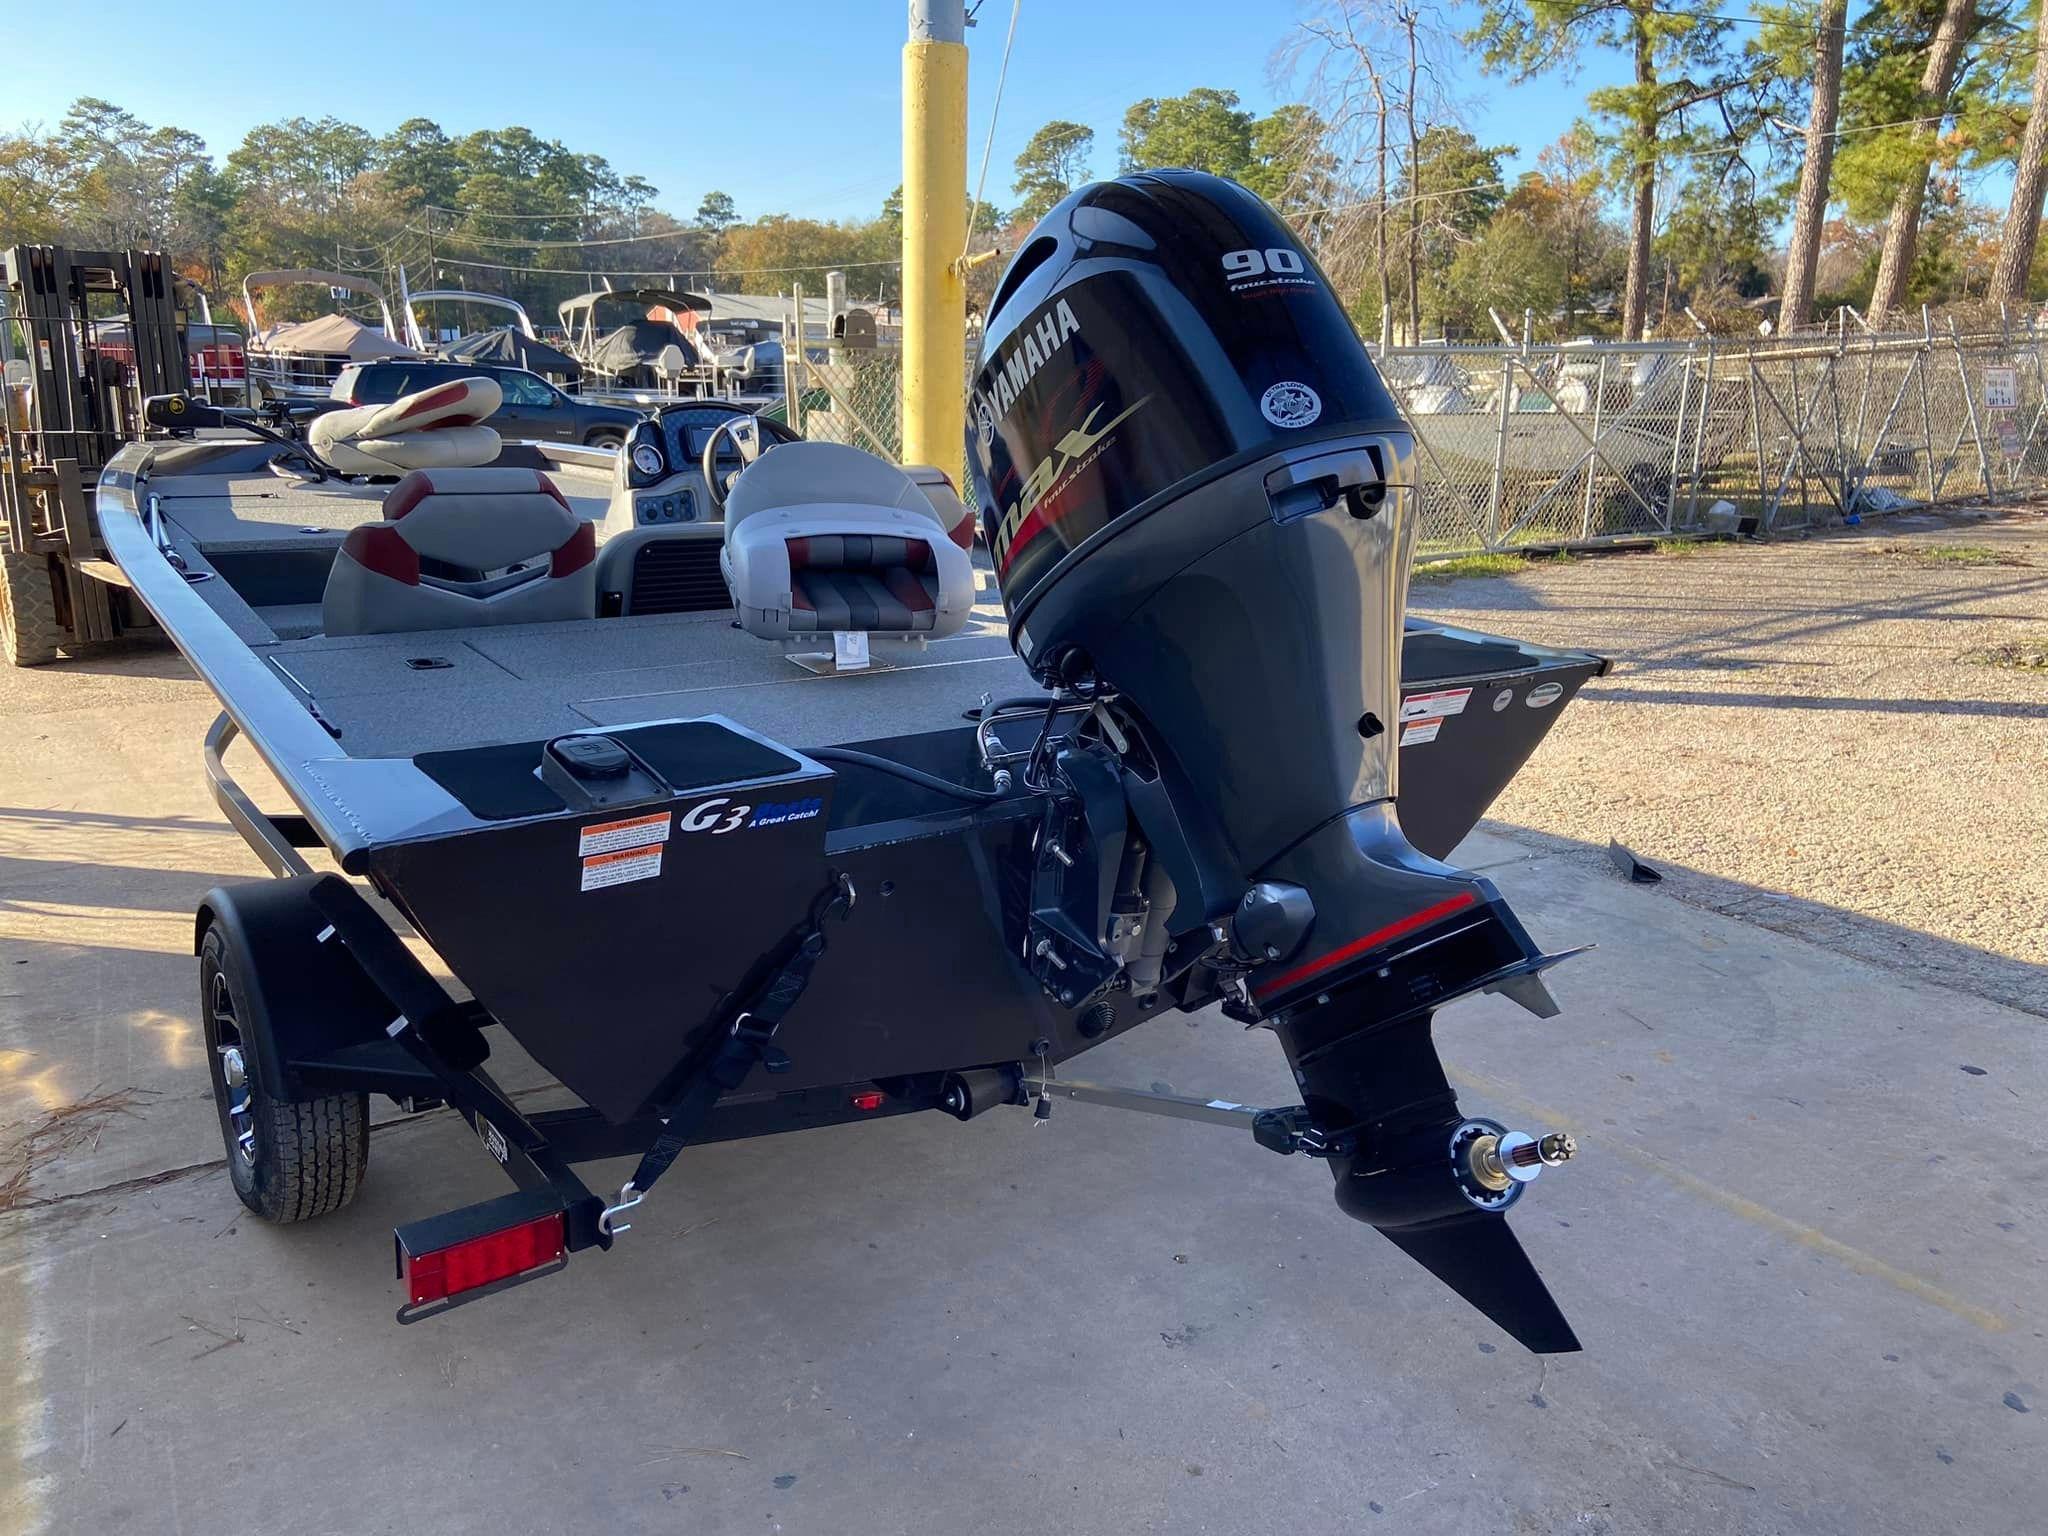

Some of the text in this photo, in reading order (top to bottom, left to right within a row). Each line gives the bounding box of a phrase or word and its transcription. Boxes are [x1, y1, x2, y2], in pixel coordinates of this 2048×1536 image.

[1222, 248, 1304, 280] 90
[987, 298, 1081, 422] YAMAHA
[680, 798, 751, 835] G3
[749, 809, 820, 829] A Great Catch!
